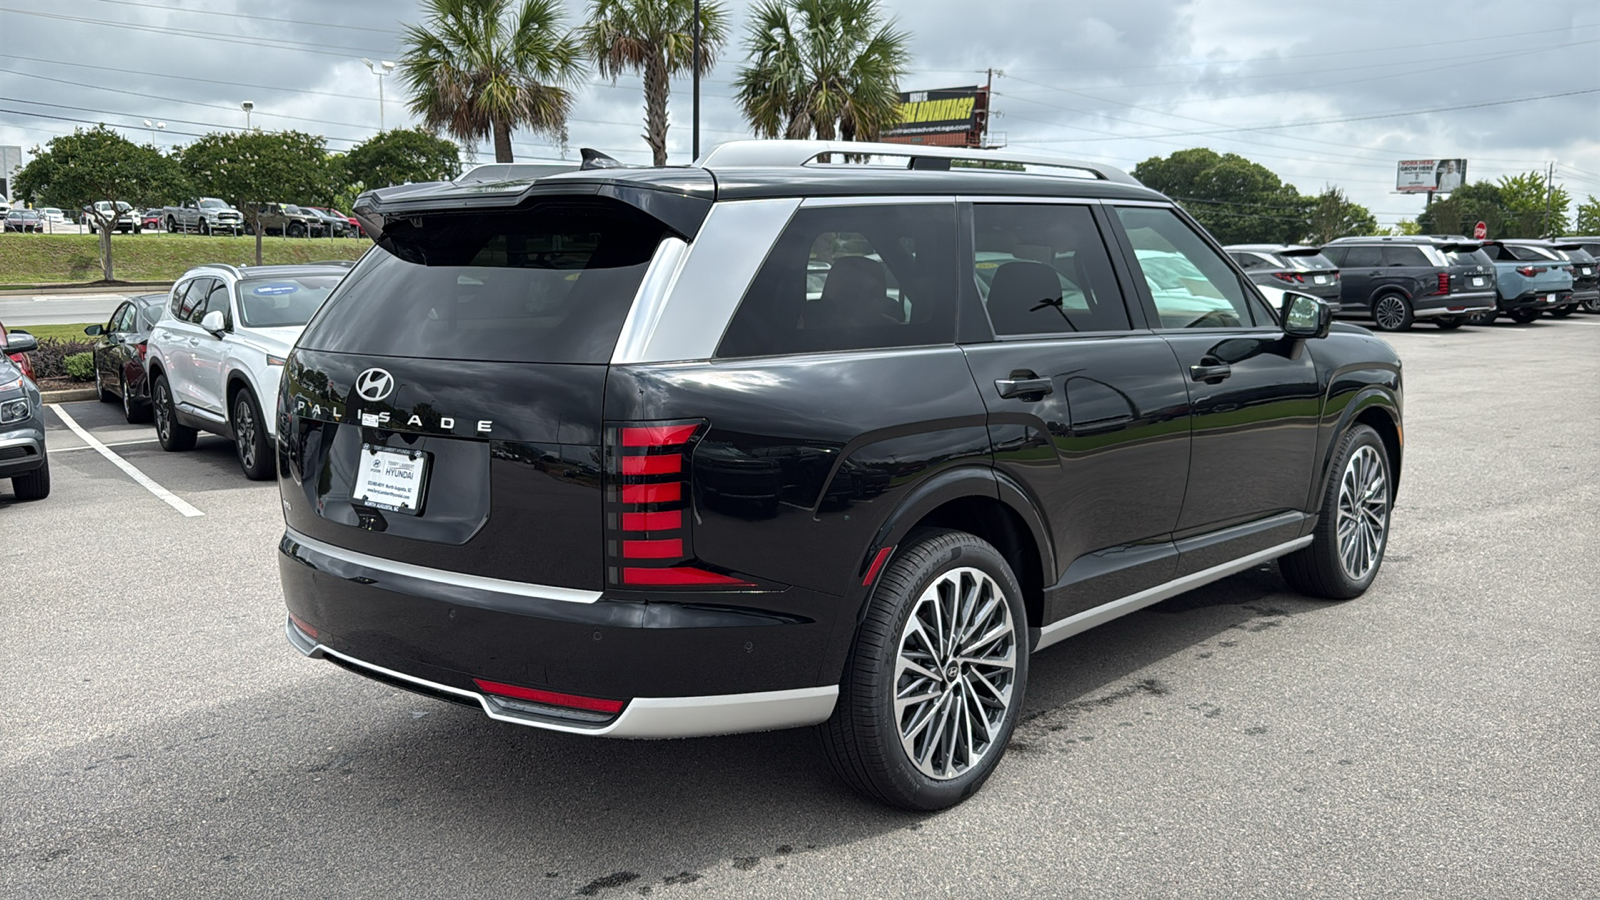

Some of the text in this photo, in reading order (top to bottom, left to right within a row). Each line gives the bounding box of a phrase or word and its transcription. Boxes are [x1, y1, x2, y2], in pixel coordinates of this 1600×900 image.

[915, 97, 975, 122] ADVANTAGE?
[1475, 227, 1486, 237] STOP
[297, 401, 494, 432] PALISADE
[386, 468, 414, 480] HYUNDAI
[890, 568, 929, 646] SCORPION
